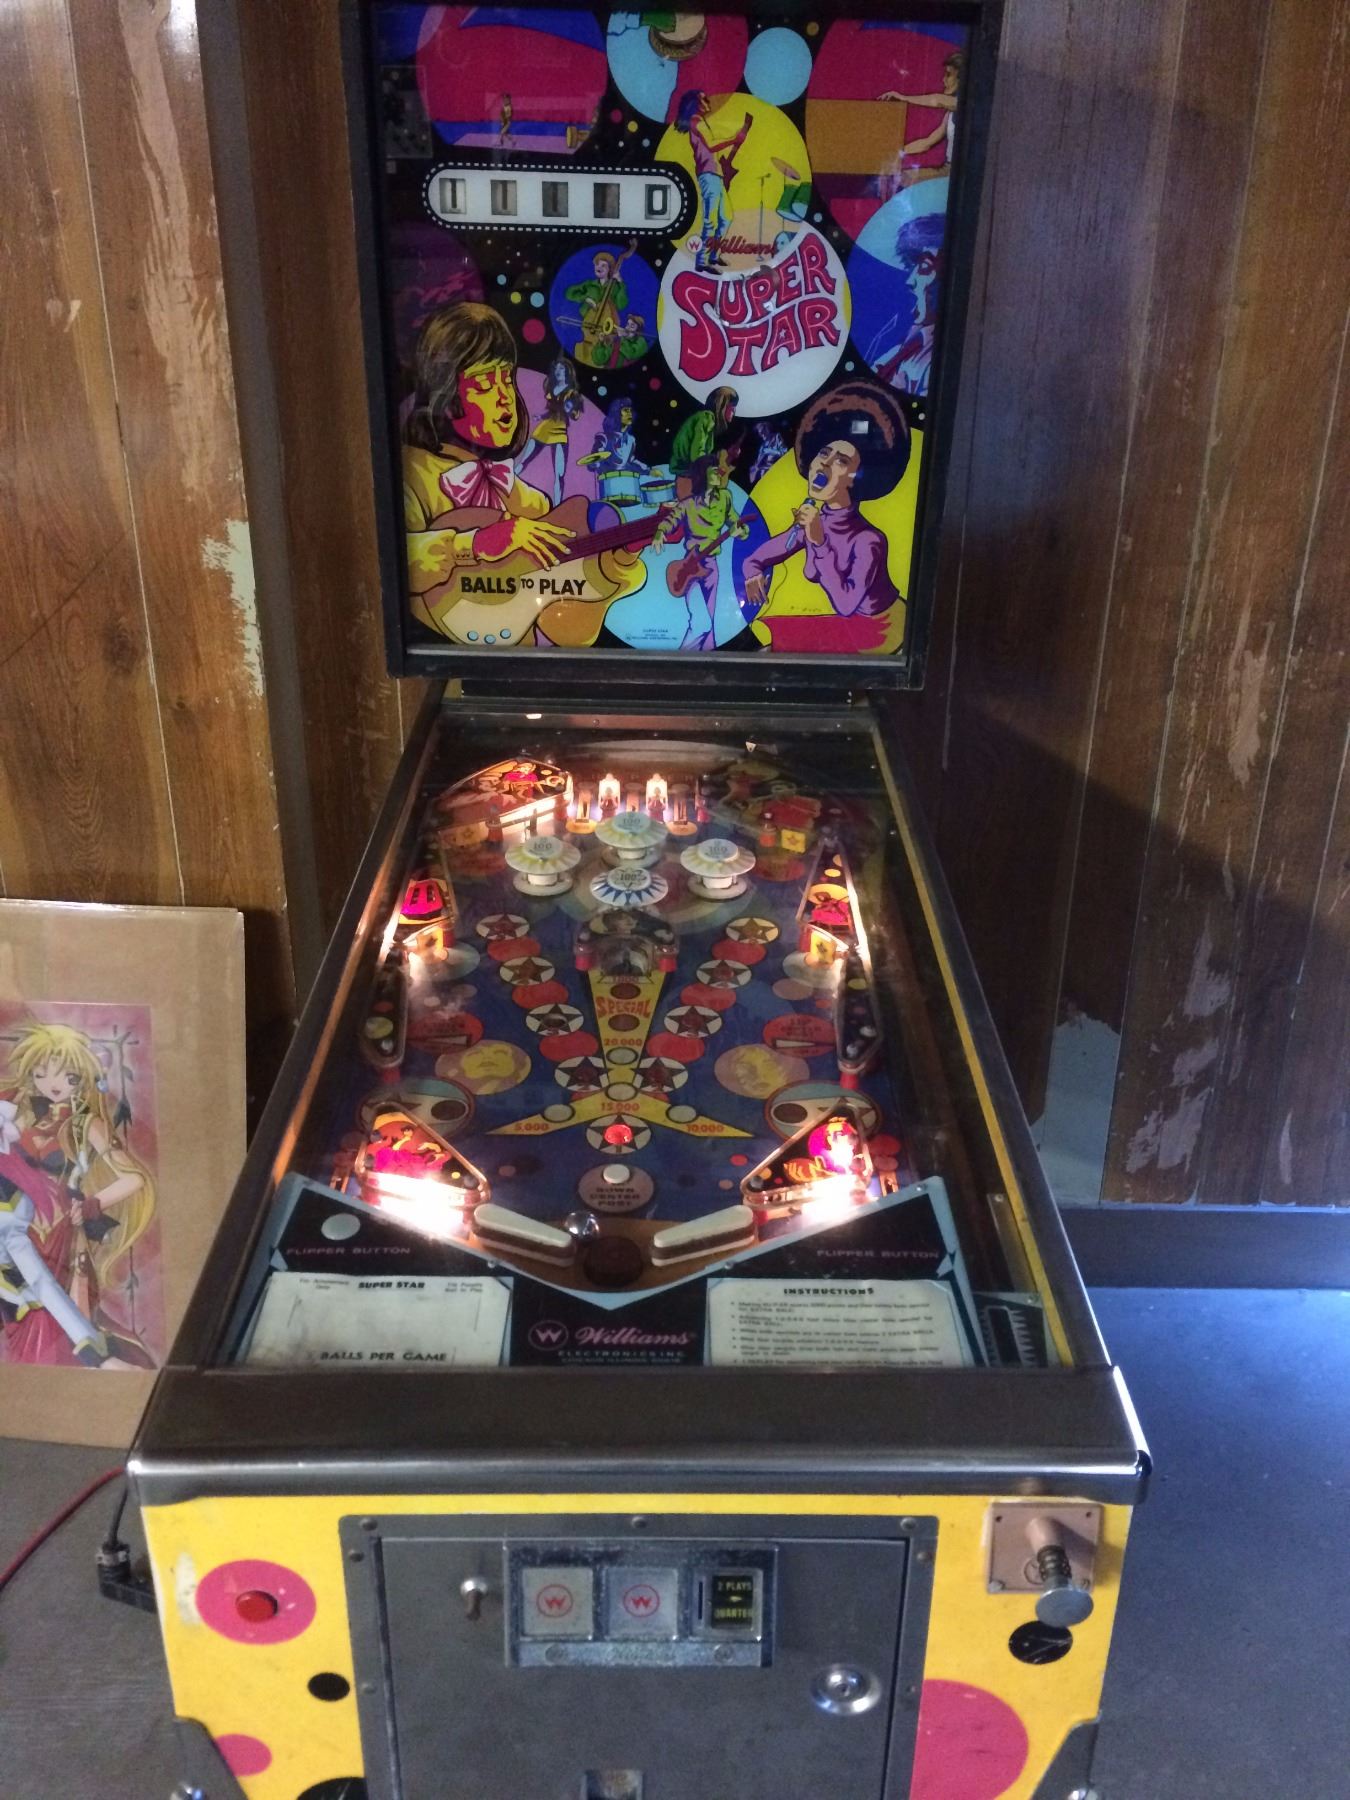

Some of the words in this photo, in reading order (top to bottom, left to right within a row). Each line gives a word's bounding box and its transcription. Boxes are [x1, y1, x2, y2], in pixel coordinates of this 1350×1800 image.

[672, 233, 836, 382] SUPER
[460, 576, 517, 594] BALLS
[521, 578, 535, 588] TO
[540, 579, 587, 595] PLAY
[595, 996, 652, 1018] SPECIAL
[352, 1247, 411, 1255] BUTTON
[816, 1249, 875, 1257] FLIPPER
[881, 1250, 939, 1259] BUTTON
[357, 1281, 393, 1290] SUPER
[396, 1281, 426, 1289] STAR
[783, 1287, 875, 1295] INSTRUCTIONS
[575, 1326, 689, 1346] Williams
[319, 1352, 363, 1361] BALLS
[370, 1352, 395, 1361] PER
[402, 1352, 448, 1361] GAME
